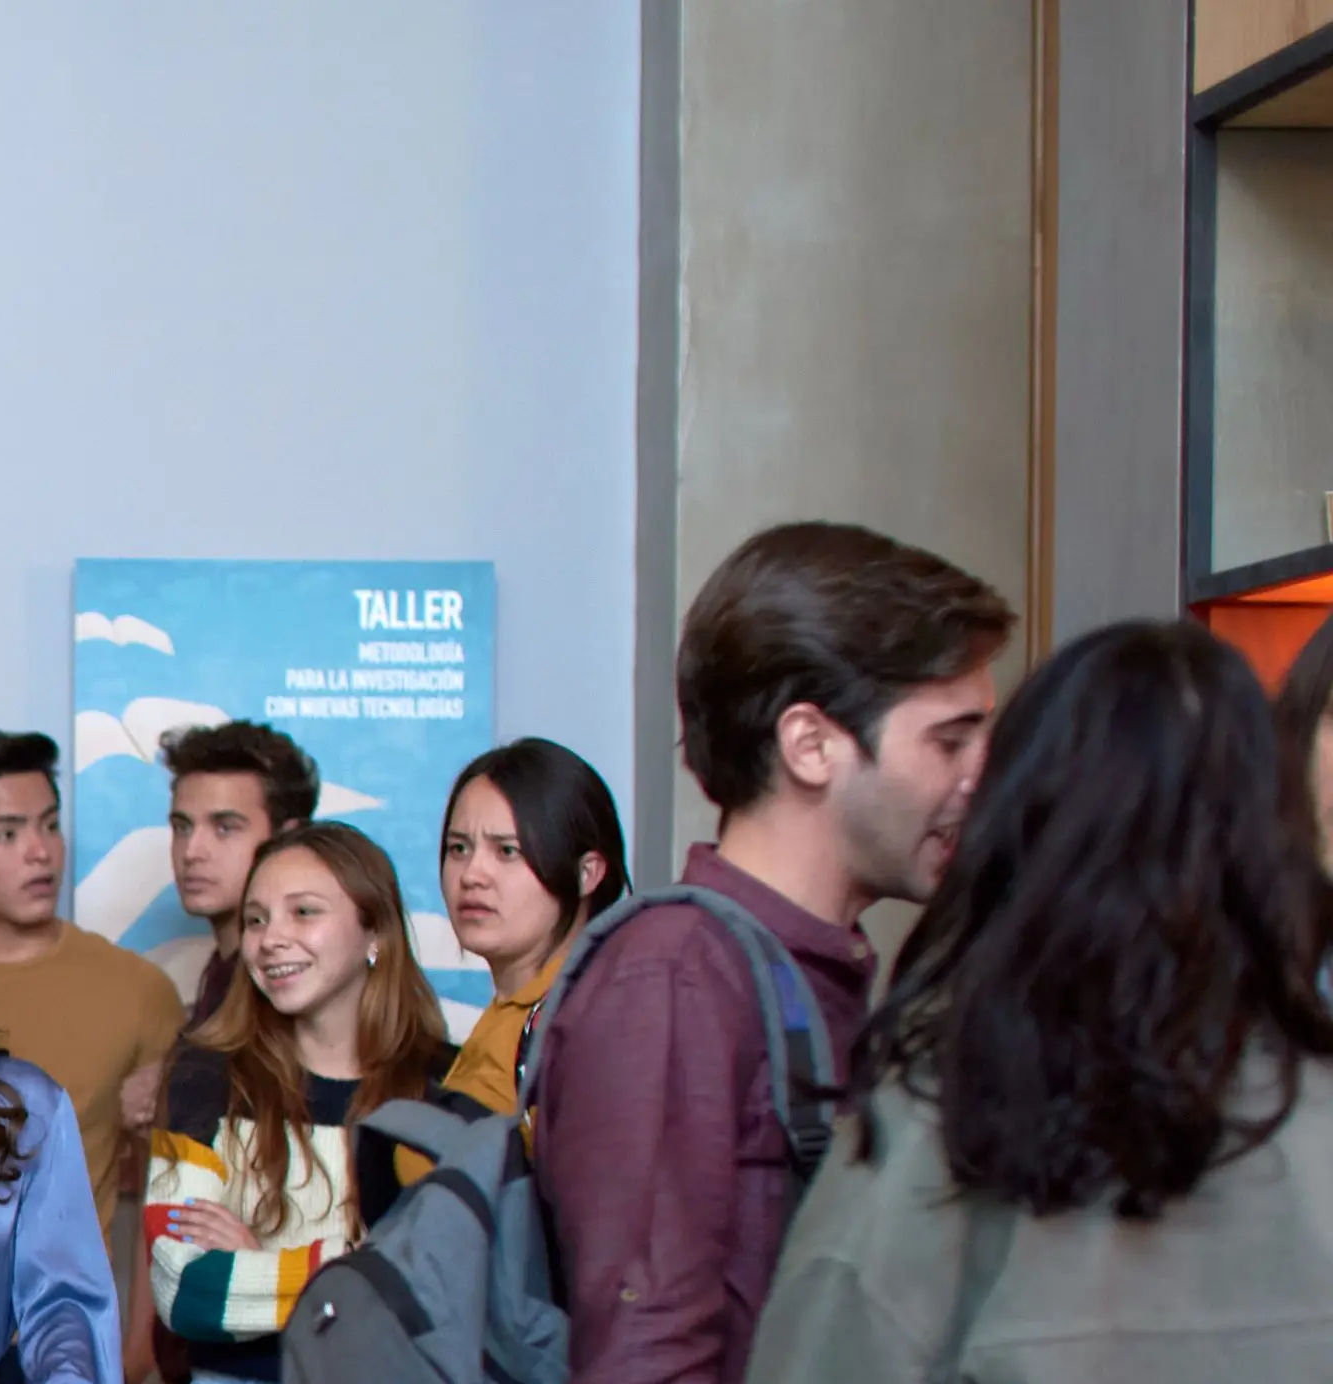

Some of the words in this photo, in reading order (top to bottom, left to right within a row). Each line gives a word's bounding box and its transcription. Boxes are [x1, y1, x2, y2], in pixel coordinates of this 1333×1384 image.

[354, 589, 463, 629] TALLER
[286, 668, 326, 690] PARA
[328, 668, 348, 690] LA
[351, 666, 464, 690] INVESTIGACIÓN
[265, 696, 296, 717] CON
[299, 696, 359, 718] NUEVAS
[361, 694, 464, 719] TECNOLOGÍAS
